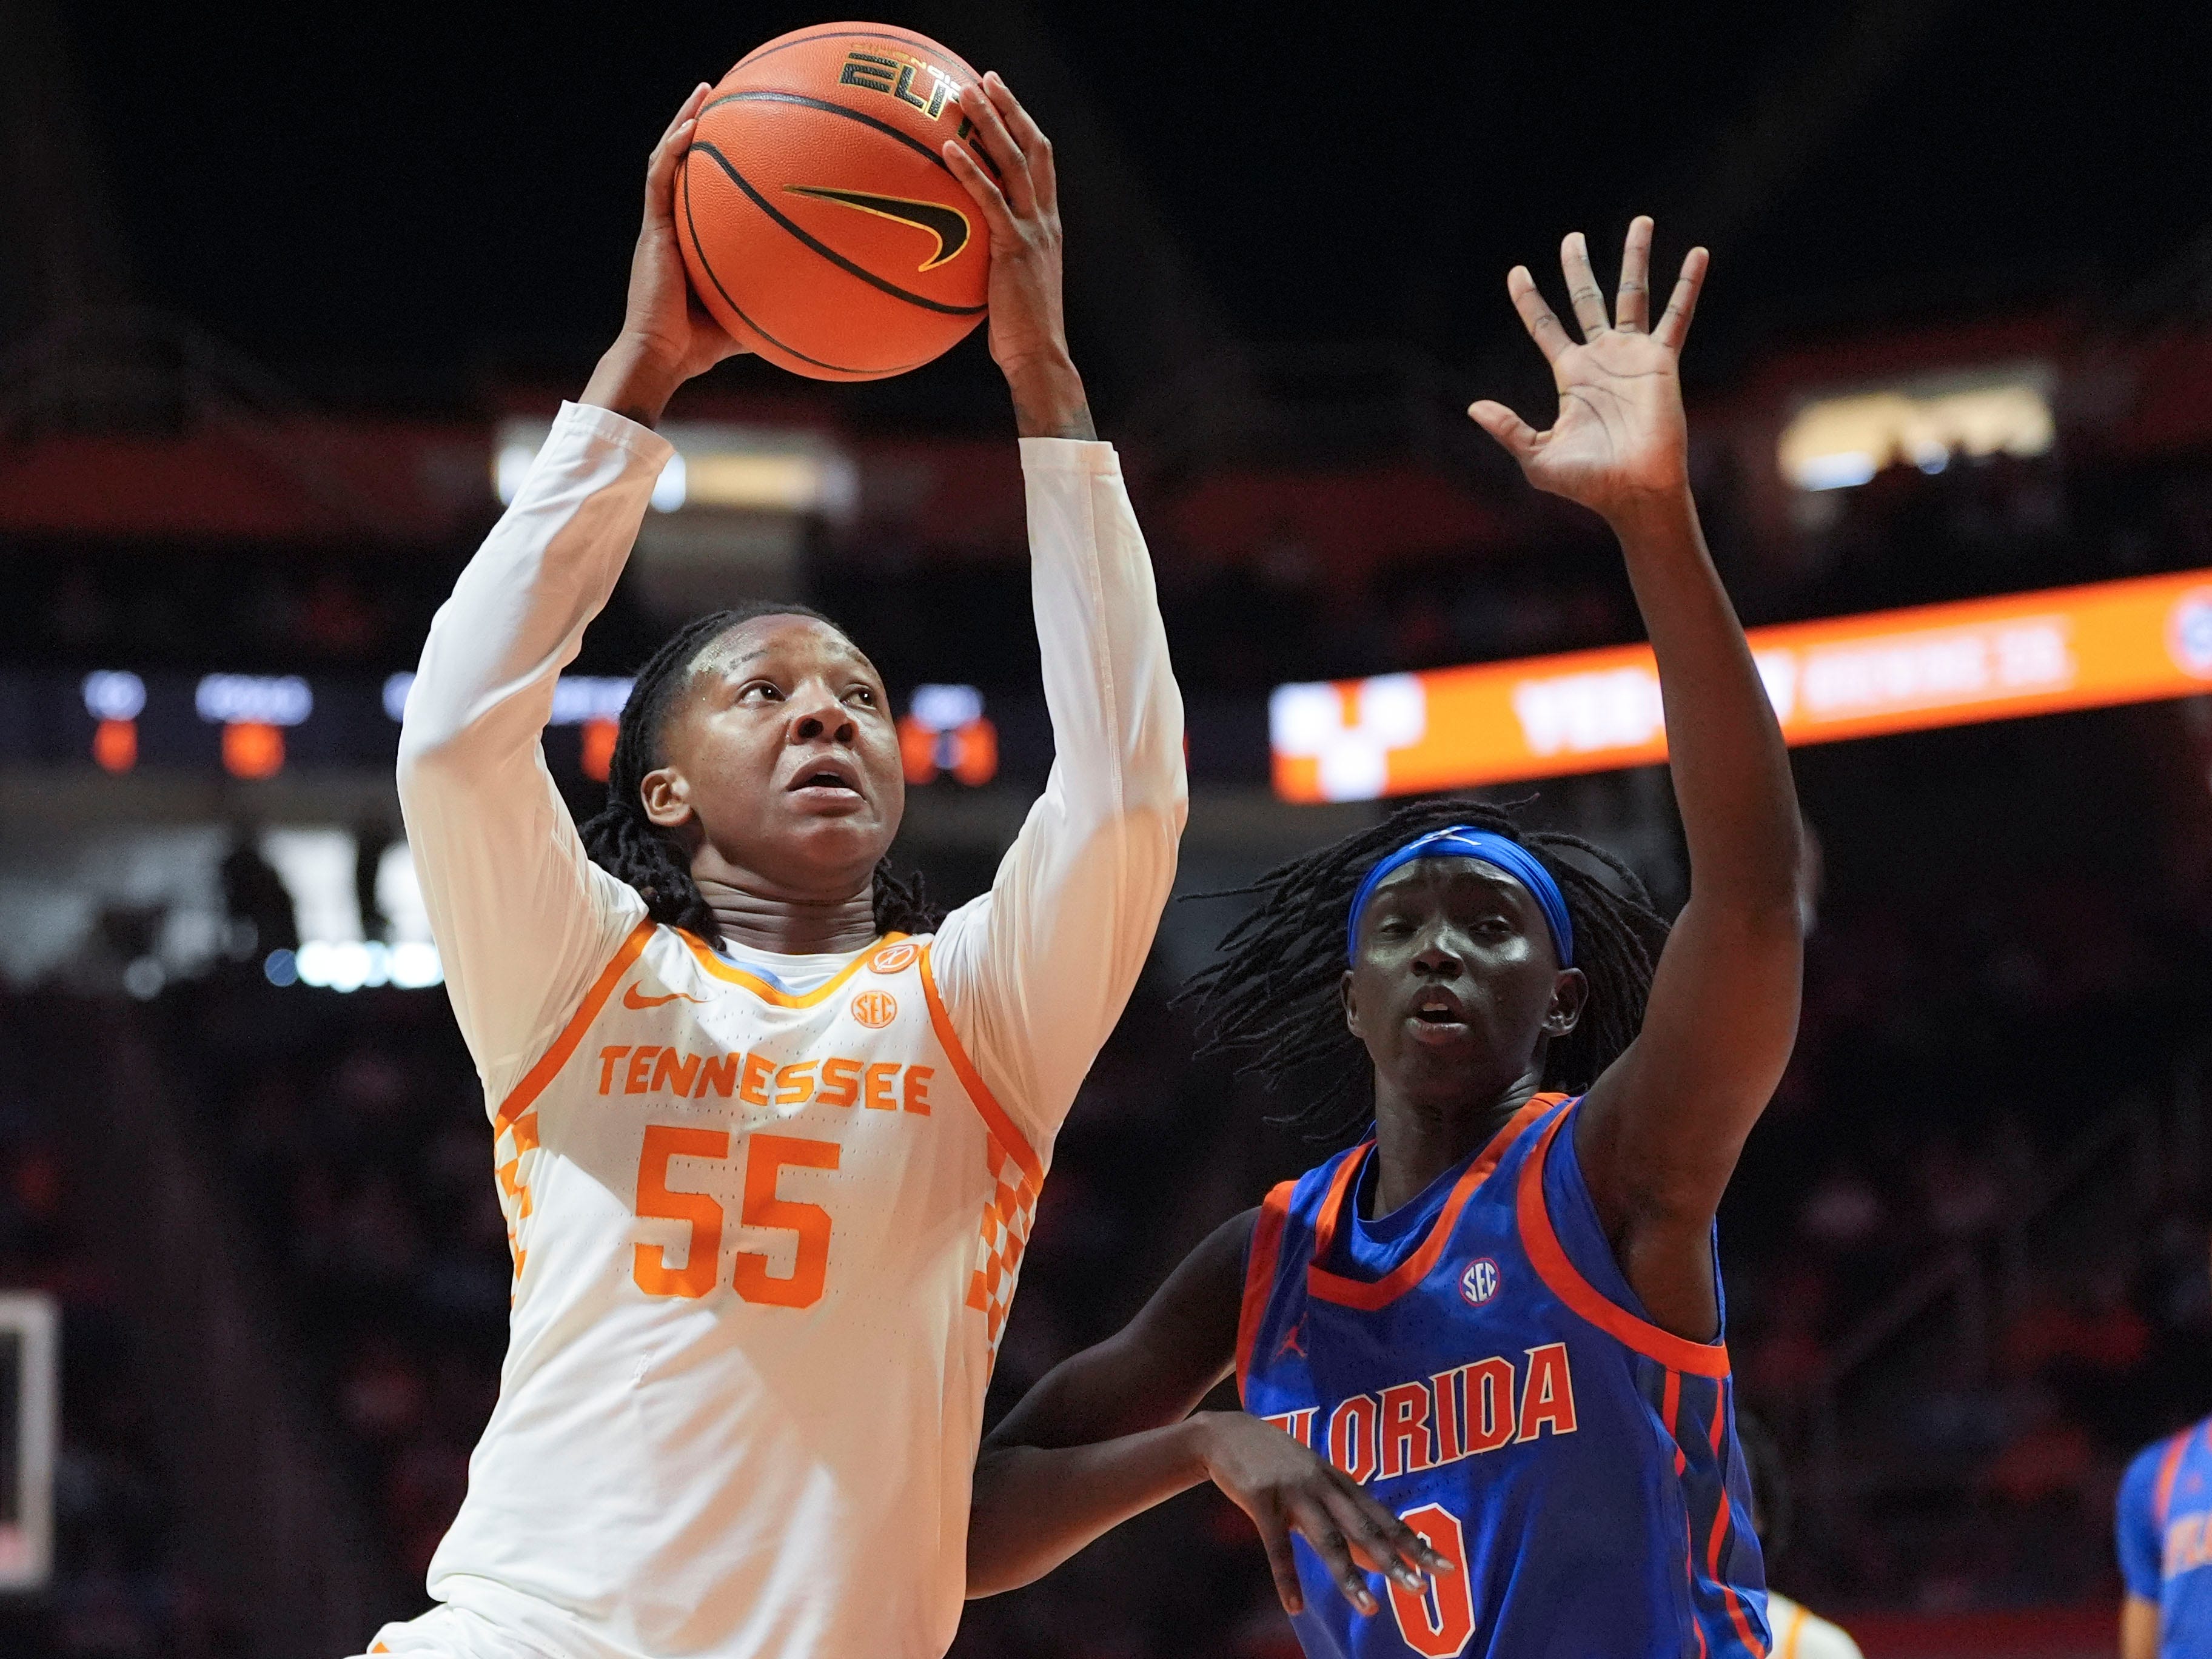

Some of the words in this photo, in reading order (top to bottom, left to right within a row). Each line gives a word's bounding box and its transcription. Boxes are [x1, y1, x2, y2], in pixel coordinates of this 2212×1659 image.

[856, 993, 892, 1025] SEC
[598, 1045, 935, 1116] TENNESSEE
[633, 1125, 841, 1309] 55
[1463, 1262, 1496, 1302] SEC
[1260, 1342, 1577, 1486] ORIDA
[1386, 1502, 1476, 1658] 0
